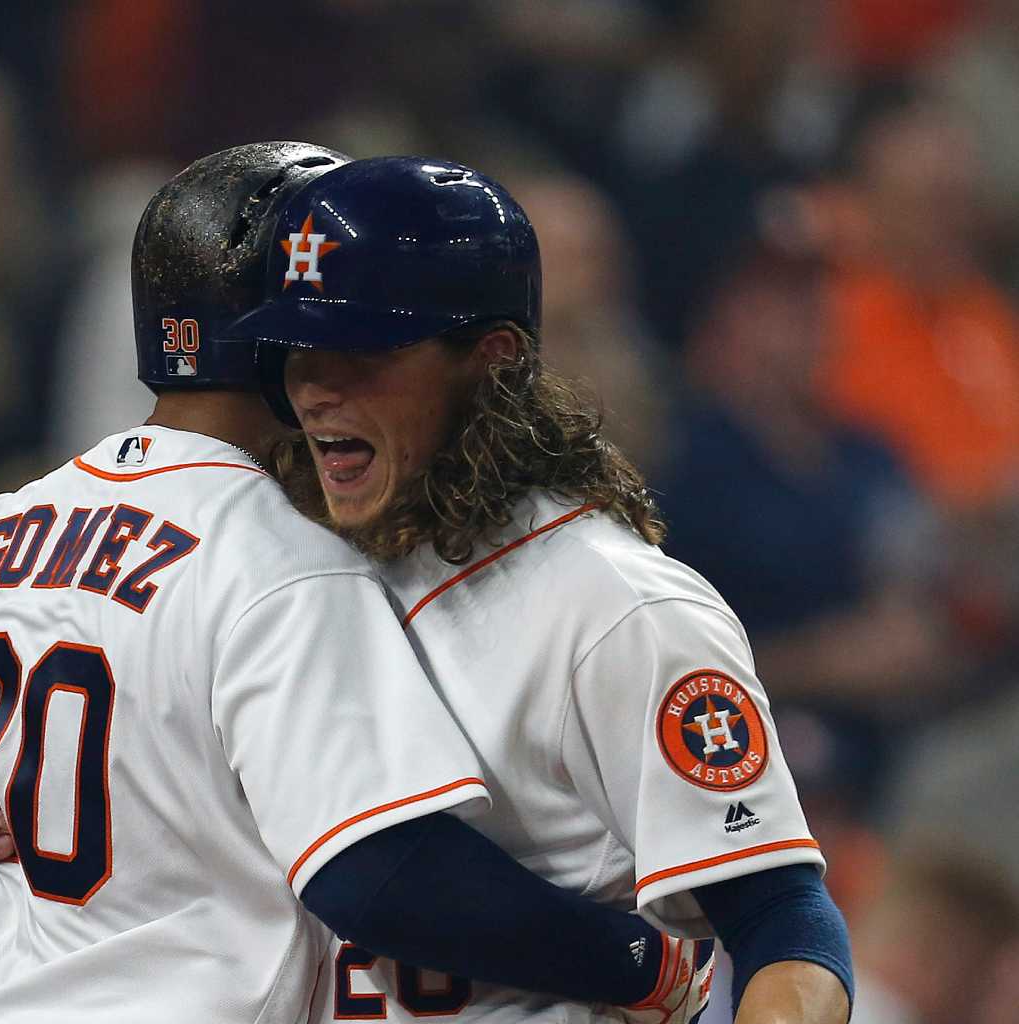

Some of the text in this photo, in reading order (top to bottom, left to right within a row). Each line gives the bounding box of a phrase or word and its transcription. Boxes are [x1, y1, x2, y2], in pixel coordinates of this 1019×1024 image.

[285, 232, 327, 281] H
[162, 317, 199, 353] 30
[668, 678, 746, 717] HOUSTON
[694, 709, 740, 755] H
[690, 751, 761, 783] ASTROS
[724, 817, 761, 834] Majestic
